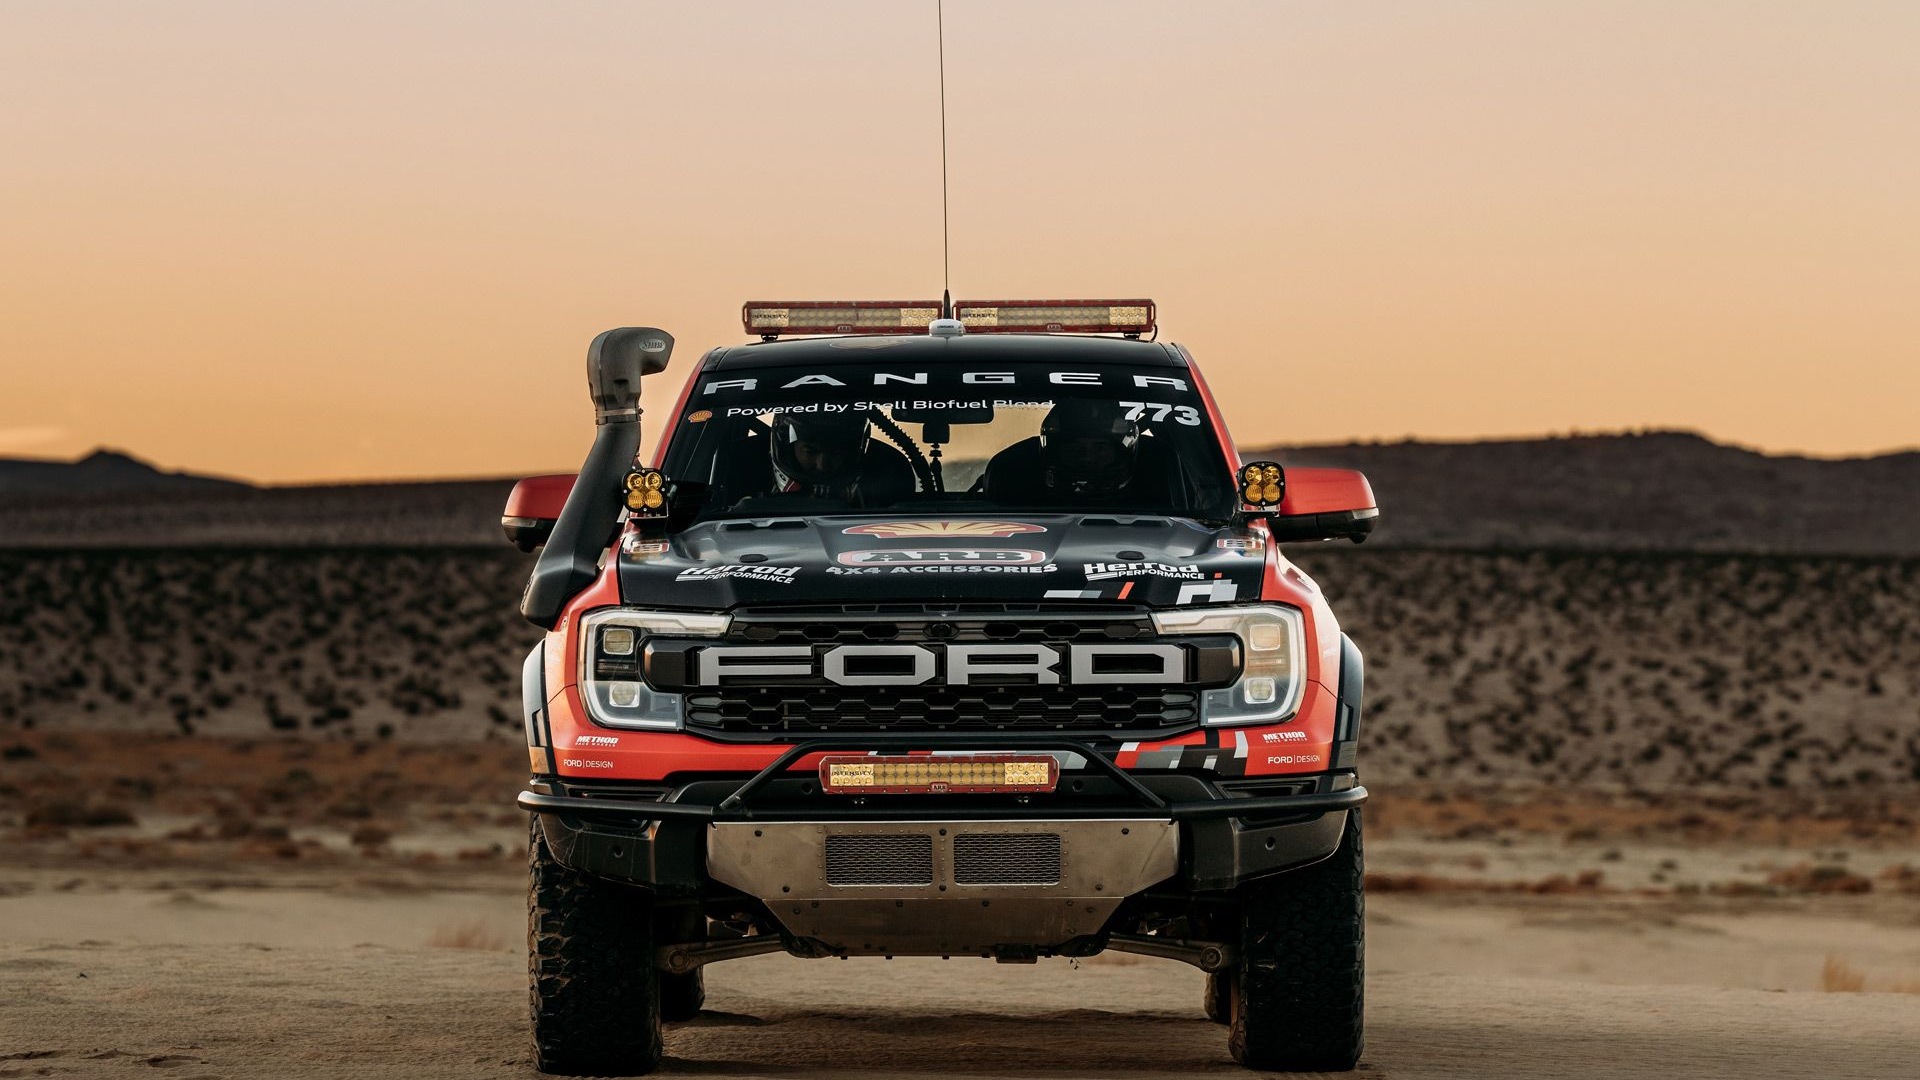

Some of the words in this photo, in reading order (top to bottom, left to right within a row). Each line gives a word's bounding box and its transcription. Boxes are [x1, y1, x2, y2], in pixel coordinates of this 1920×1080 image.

[703, 372, 1188, 395] RANGER
[727, 403, 818, 417] Powered
[824, 402, 848, 412] by
[853, 400, 907, 411] Shell
[913, 400, 988, 409] Biofuel
[994, 400, 1053, 410] Blend
[1119, 401, 1201, 426] 773
[862, 552, 1029, 562] ARB
[680, 565, 802, 576] Herrod
[890, 564, 1058, 573] ACCESSORIES
[1083, 562, 1199, 574] Herrod
[705, 571, 795, 584] PERFORMANCE
[1118, 568, 1205, 580] PERFORMANCE
[699, 644, 1184, 686] FORD
[576, 735, 619, 744] METHOD
[1262, 731, 1306, 740] METHOD
[563, 759, 582, 768] FORD
[585, 760, 614, 769] DESIGN
[1267, 756, 1293, 764] FORD
[1296, 755, 1321, 763] DESIGN
